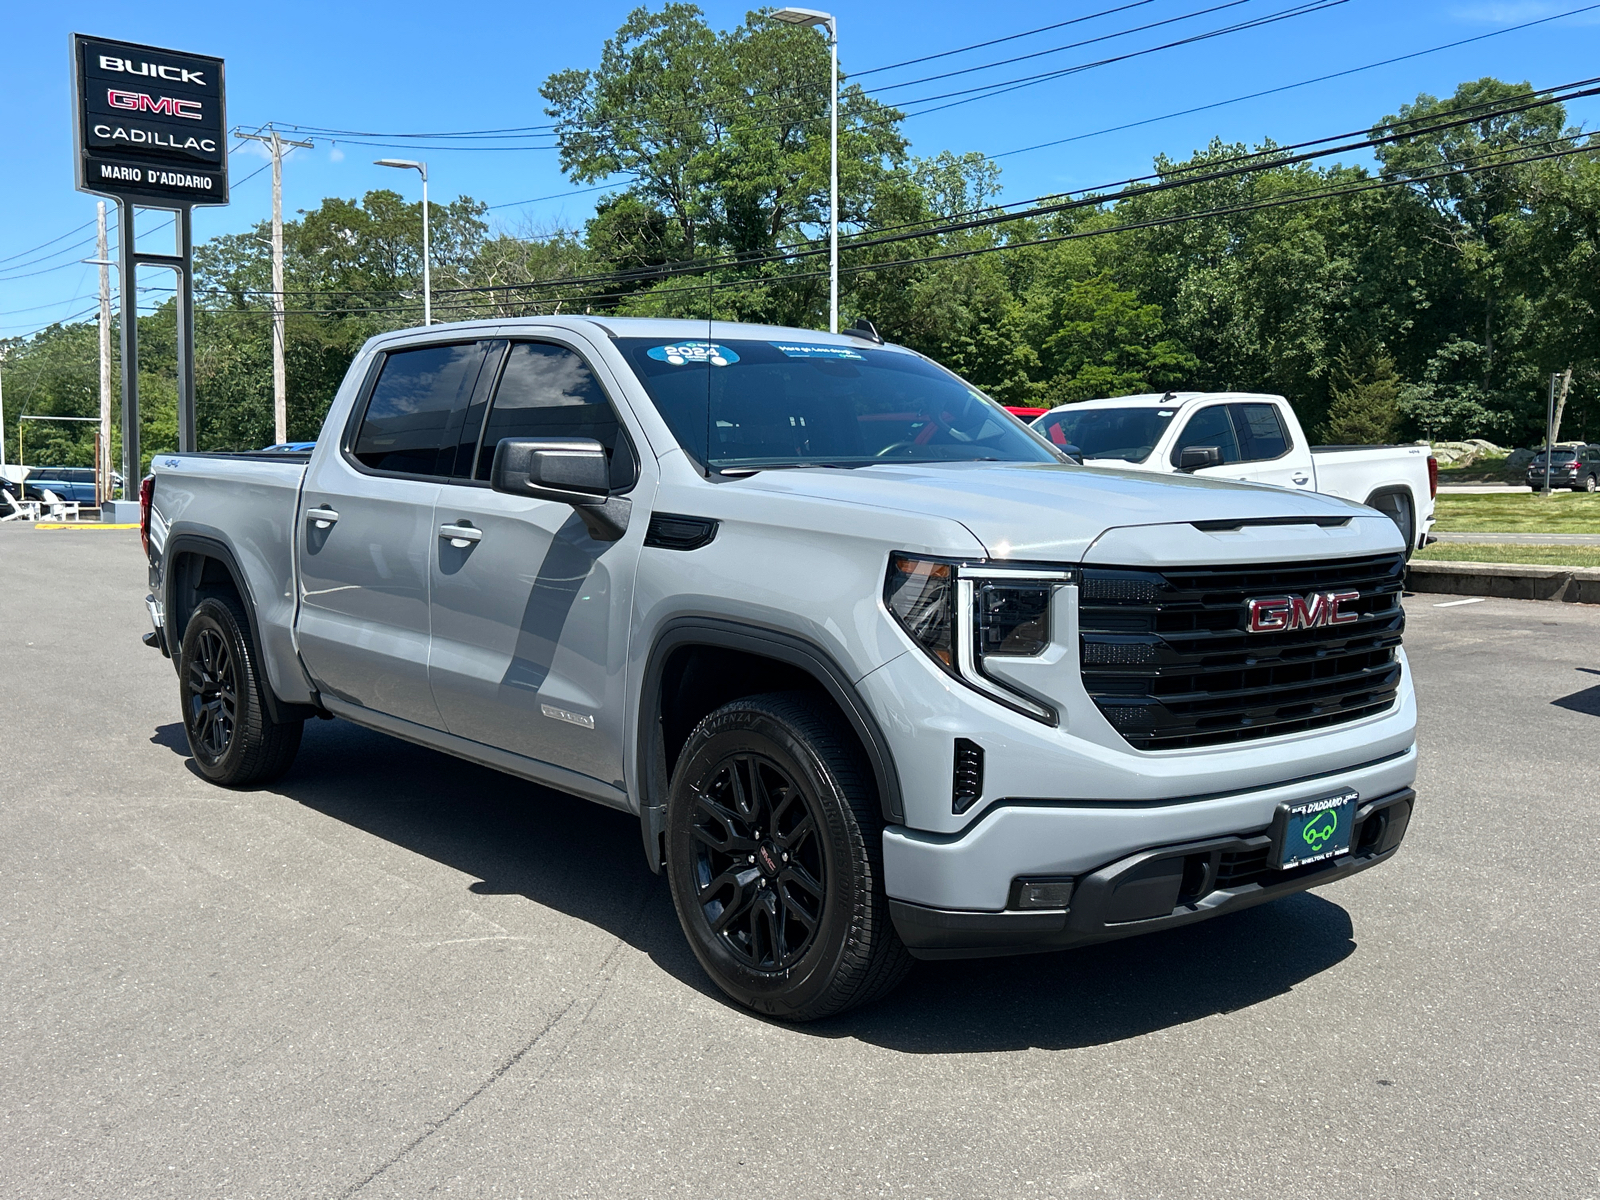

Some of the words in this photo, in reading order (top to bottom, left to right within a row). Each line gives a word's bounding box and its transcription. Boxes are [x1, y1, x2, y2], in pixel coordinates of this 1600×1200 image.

[99, 55, 207, 86] BUICK
[107, 88, 202, 120] GMC
[94, 125, 216, 152] CADILLAC
[101, 164, 142, 182] MARIO
[148, 170, 213, 190] D'ADDARIO
[664, 346, 720, 357] 2024
[1246, 591, 1360, 633] GMC
[711, 713, 751, 729] ALENZA
[760, 845, 777, 871] GMC
[822, 794, 850, 911] BRIDGESTONE
